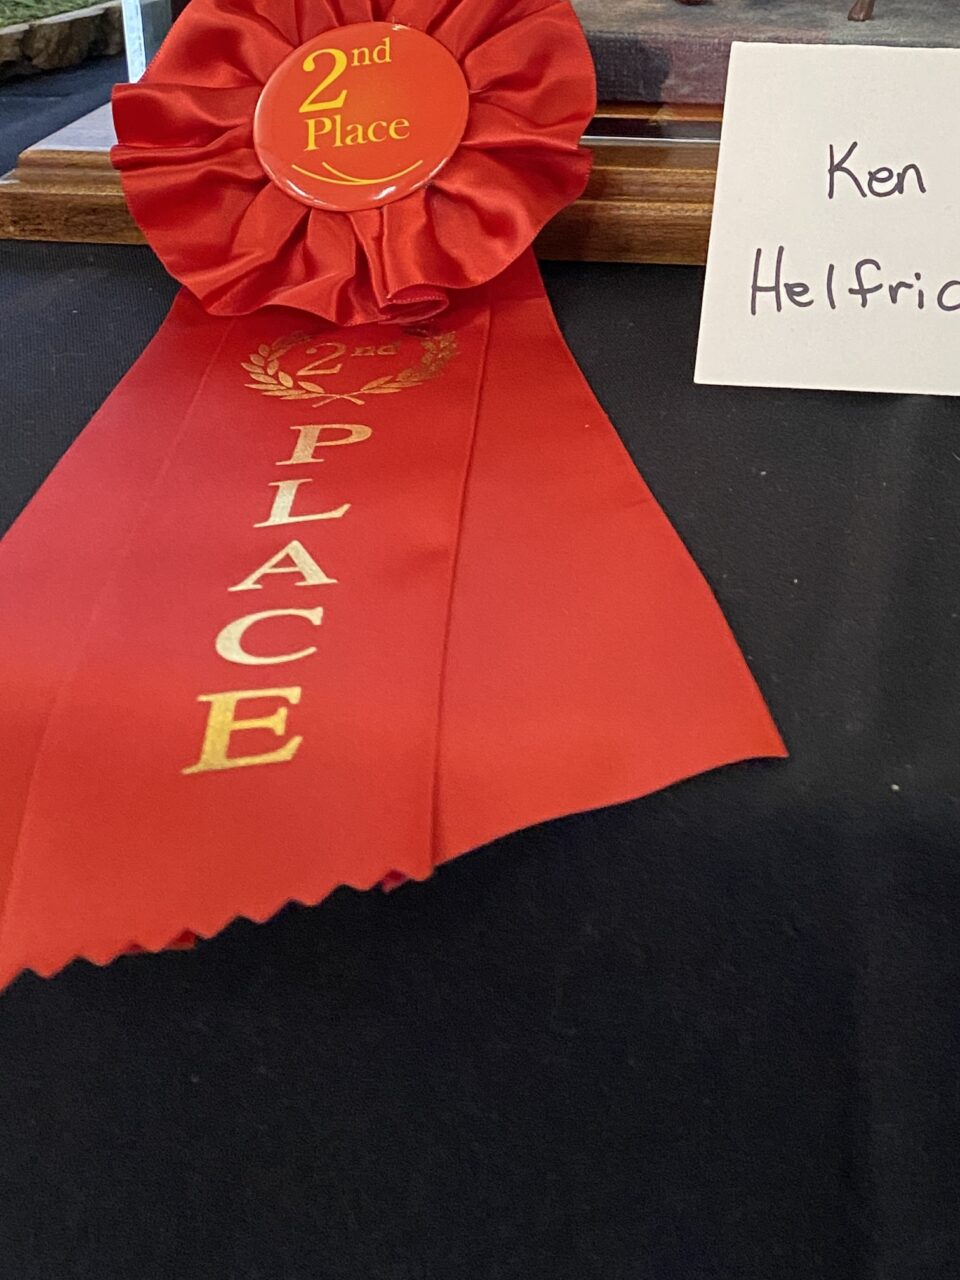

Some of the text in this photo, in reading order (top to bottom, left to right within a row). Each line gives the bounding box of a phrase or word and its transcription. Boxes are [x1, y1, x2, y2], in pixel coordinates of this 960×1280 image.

[299, 37, 392, 113] 2nd
[303, 114, 410, 152] Place
[827, 141, 927, 200] Ken
[296, 340, 400, 376] 2nd
[181, 423, 373, 776] PLACE
